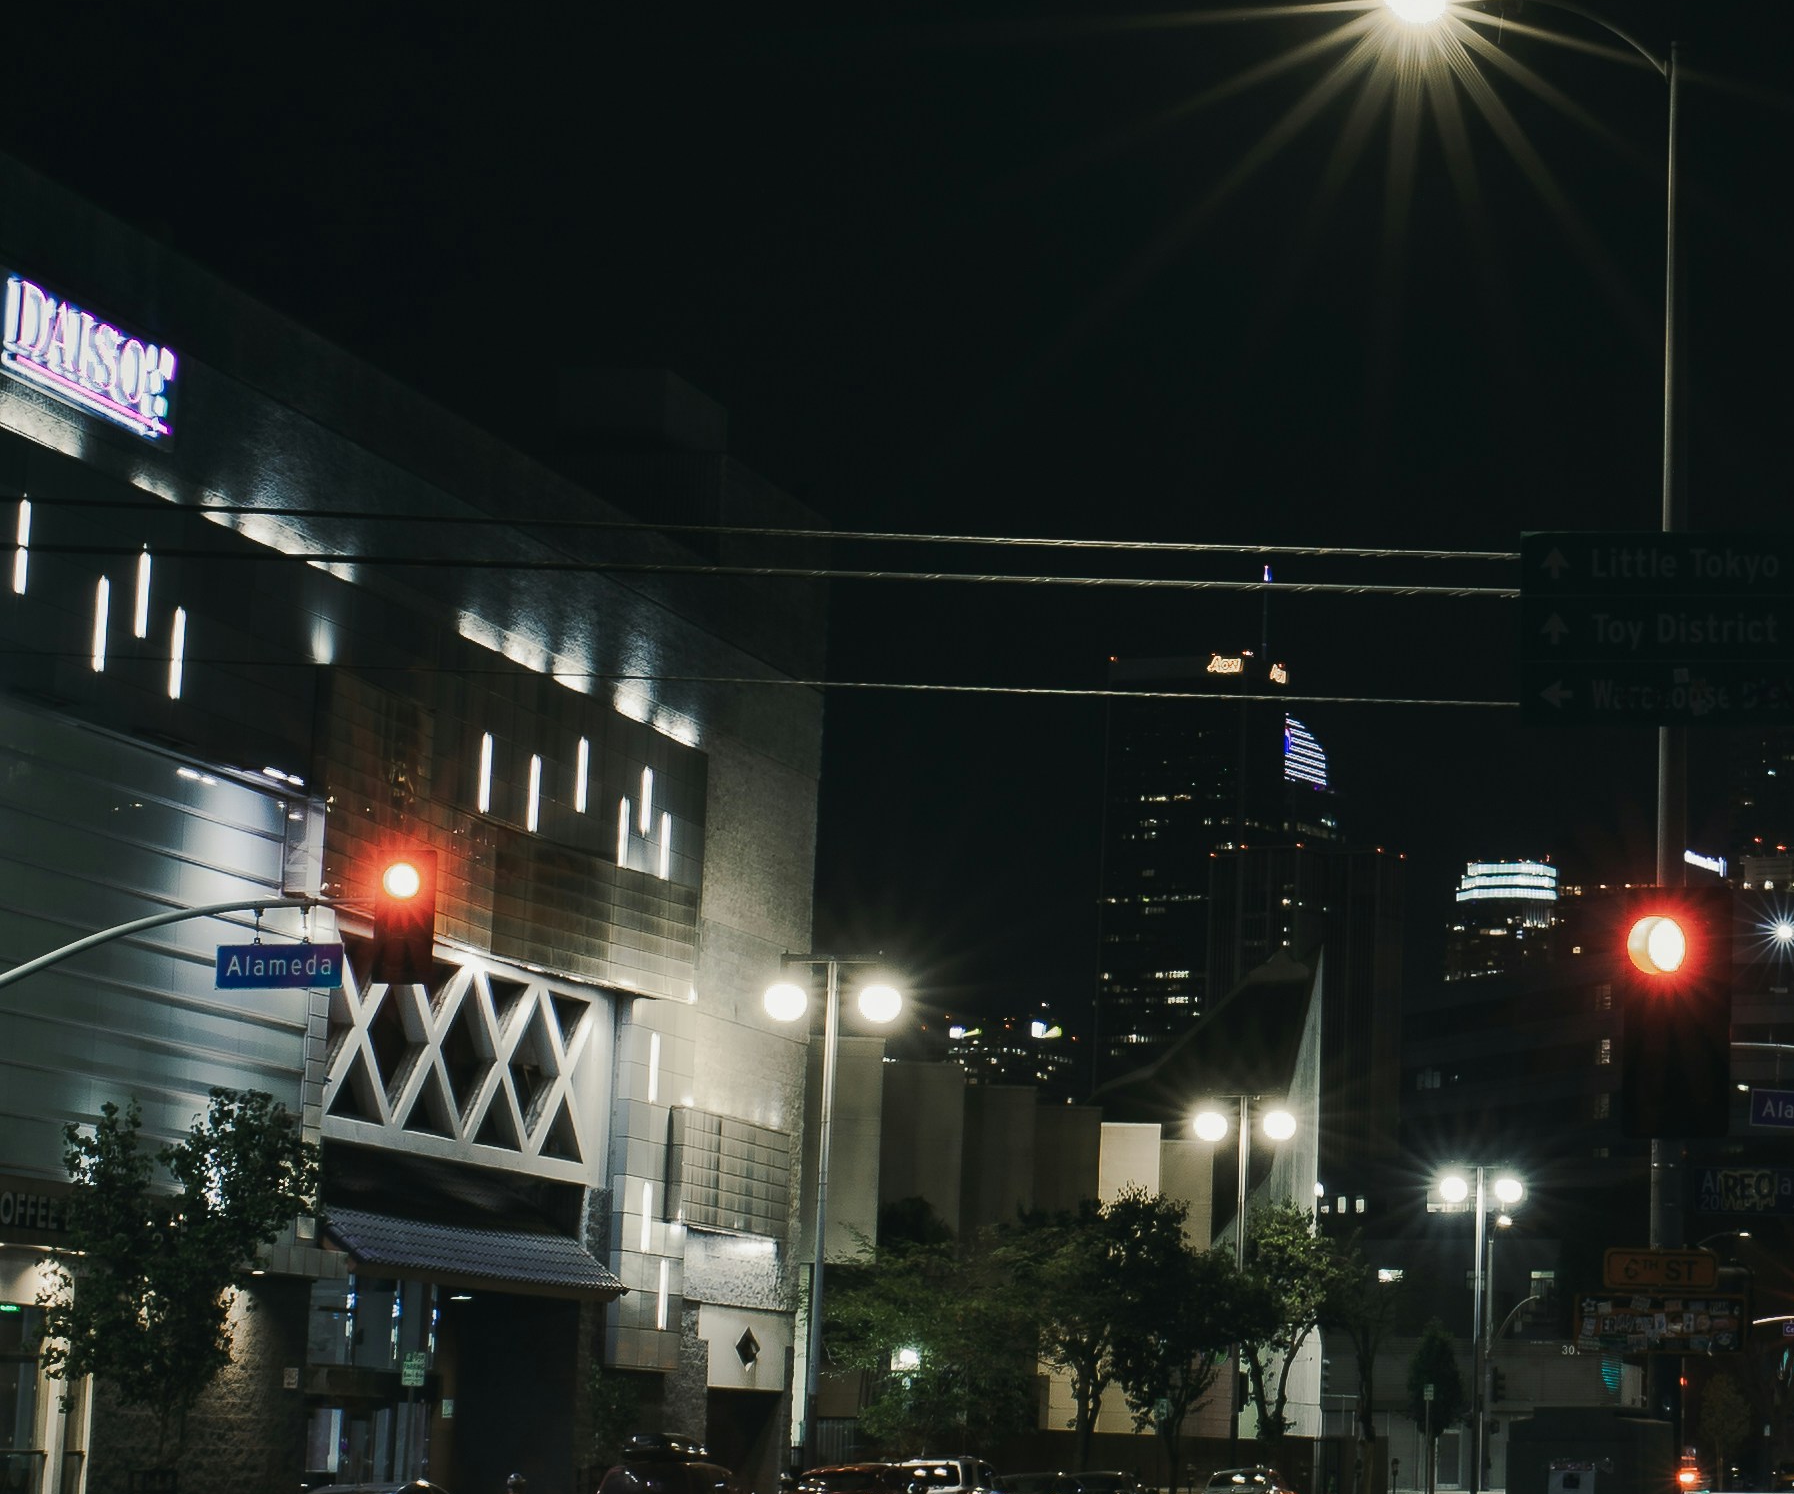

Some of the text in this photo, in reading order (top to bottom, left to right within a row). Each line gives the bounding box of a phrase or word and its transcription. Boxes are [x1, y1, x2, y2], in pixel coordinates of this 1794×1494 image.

[1591, 548, 1779, 584] Little Tokyo
[1592, 612, 1778, 650] Toy District
[226, 954, 332, 977] Alameda
[1623, 1258, 1698, 1281] 6TH ST
